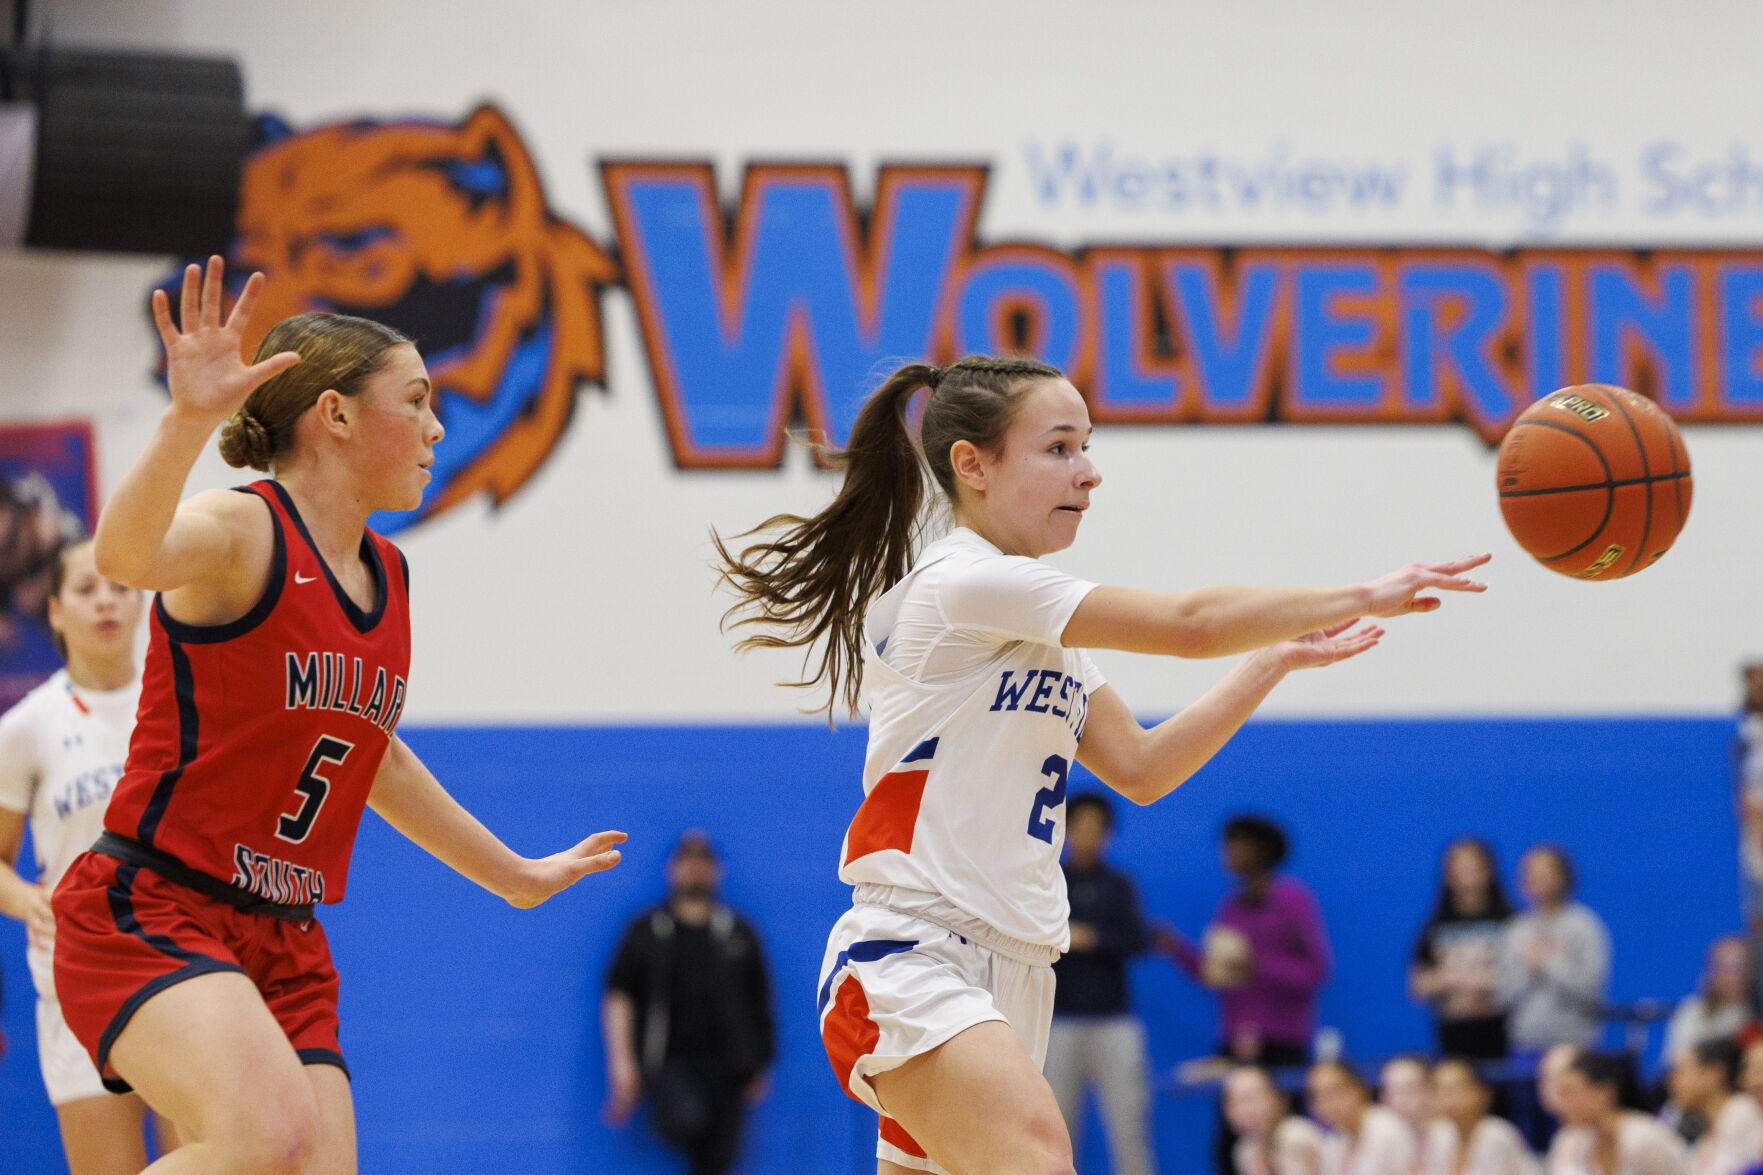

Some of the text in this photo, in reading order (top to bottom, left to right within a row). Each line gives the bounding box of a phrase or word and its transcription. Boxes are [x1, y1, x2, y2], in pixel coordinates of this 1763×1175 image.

[1024, 136, 1407, 213] Westview
[1432, 136, 1620, 238] High
[285, 651, 407, 738] MILLAR
[273, 733, 356, 844] 5
[1026, 753, 1068, 846] 2
[231, 843, 325, 904] SOUTH
